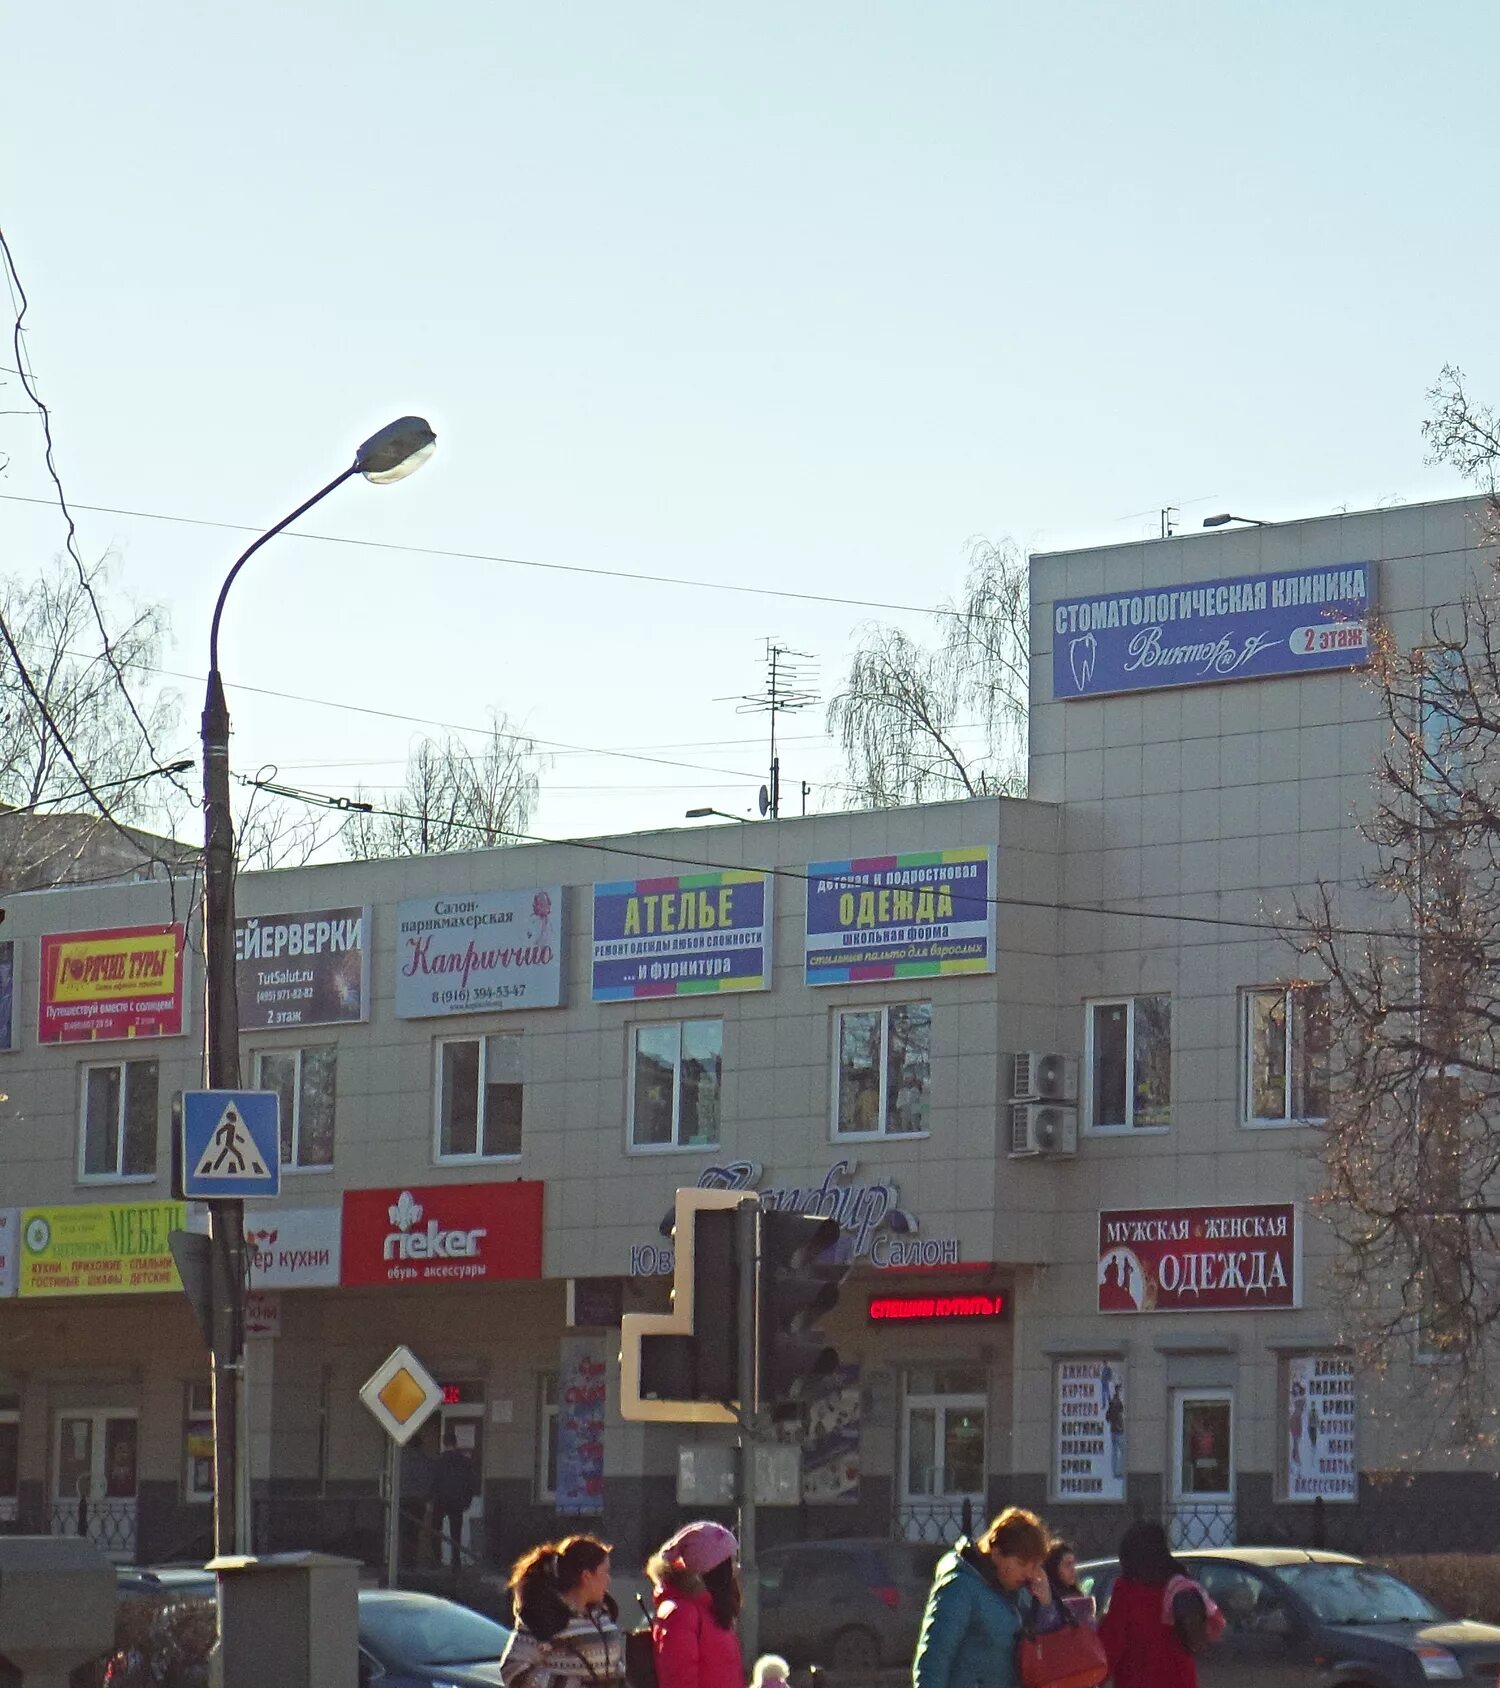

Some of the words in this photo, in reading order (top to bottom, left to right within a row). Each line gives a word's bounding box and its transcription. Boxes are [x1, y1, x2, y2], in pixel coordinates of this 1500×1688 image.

[1056, 581, 1266, 634] СТОМАТОЛОГИЧЕСКАЯ
[1272, 568, 1366, 608] КЛИНИКА
[1305, 628, 1314, 651] 2
[1319, 626, 1363, 650] этаж
[886, 864, 977, 886] подростковая
[435, 901, 479, 915] Салон-
[624, 888, 733, 936] АТЕЛЬЕ
[839, 884, 953, 928] ОДЕЖДА
[401, 912, 513, 934] парикмахерская
[236, 918, 362, 961] ЕЙЕРВЕРКИ
[595, 943, 628, 957] РЕМОНТ
[630, 940, 670, 954] ОДЕЖДЫ
[707, 932, 762, 947] СЛОЖНОСТИ
[129, 950, 167, 978] ТУРЫ
[258, 970, 313, 985] TutSalut.ru
[432, 991, 439, 1003] 8
[442, 989, 470, 1004] (916)
[46, 1002, 98, 1019] Путешествуй
[100, 1002, 128, 1014] вместе
[136, 997, 174, 1012] солнцем!
[268, 1011, 273, 1023] 2
[277, 1011, 301, 1022] этаж
[383, 1220, 487, 1260] rieker
[1107, 1220, 1189, 1243] МУЖСКАЯ
[1205, 1216, 1287, 1239] ЖЕНСКАЯ
[279, 1248, 329, 1272] кухни
[871, 1239, 959, 1266] Салон
[387, 1267, 416, 1279] обувь
[424, 1264, 486, 1278] аксессуары
[1158, 1251, 1287, 1299] ОДЕЖДА
[1062, 1384, 1094, 1399] КУРТКИ
[1062, 1402, 1099, 1416] СВИТЕРА
[1062, 1421, 1104, 1436] КОСТЮМЫ
[1061, 1459, 1091, 1474] БРЮКИ
[1060, 1478, 1102, 1493] РУБАШКИ
